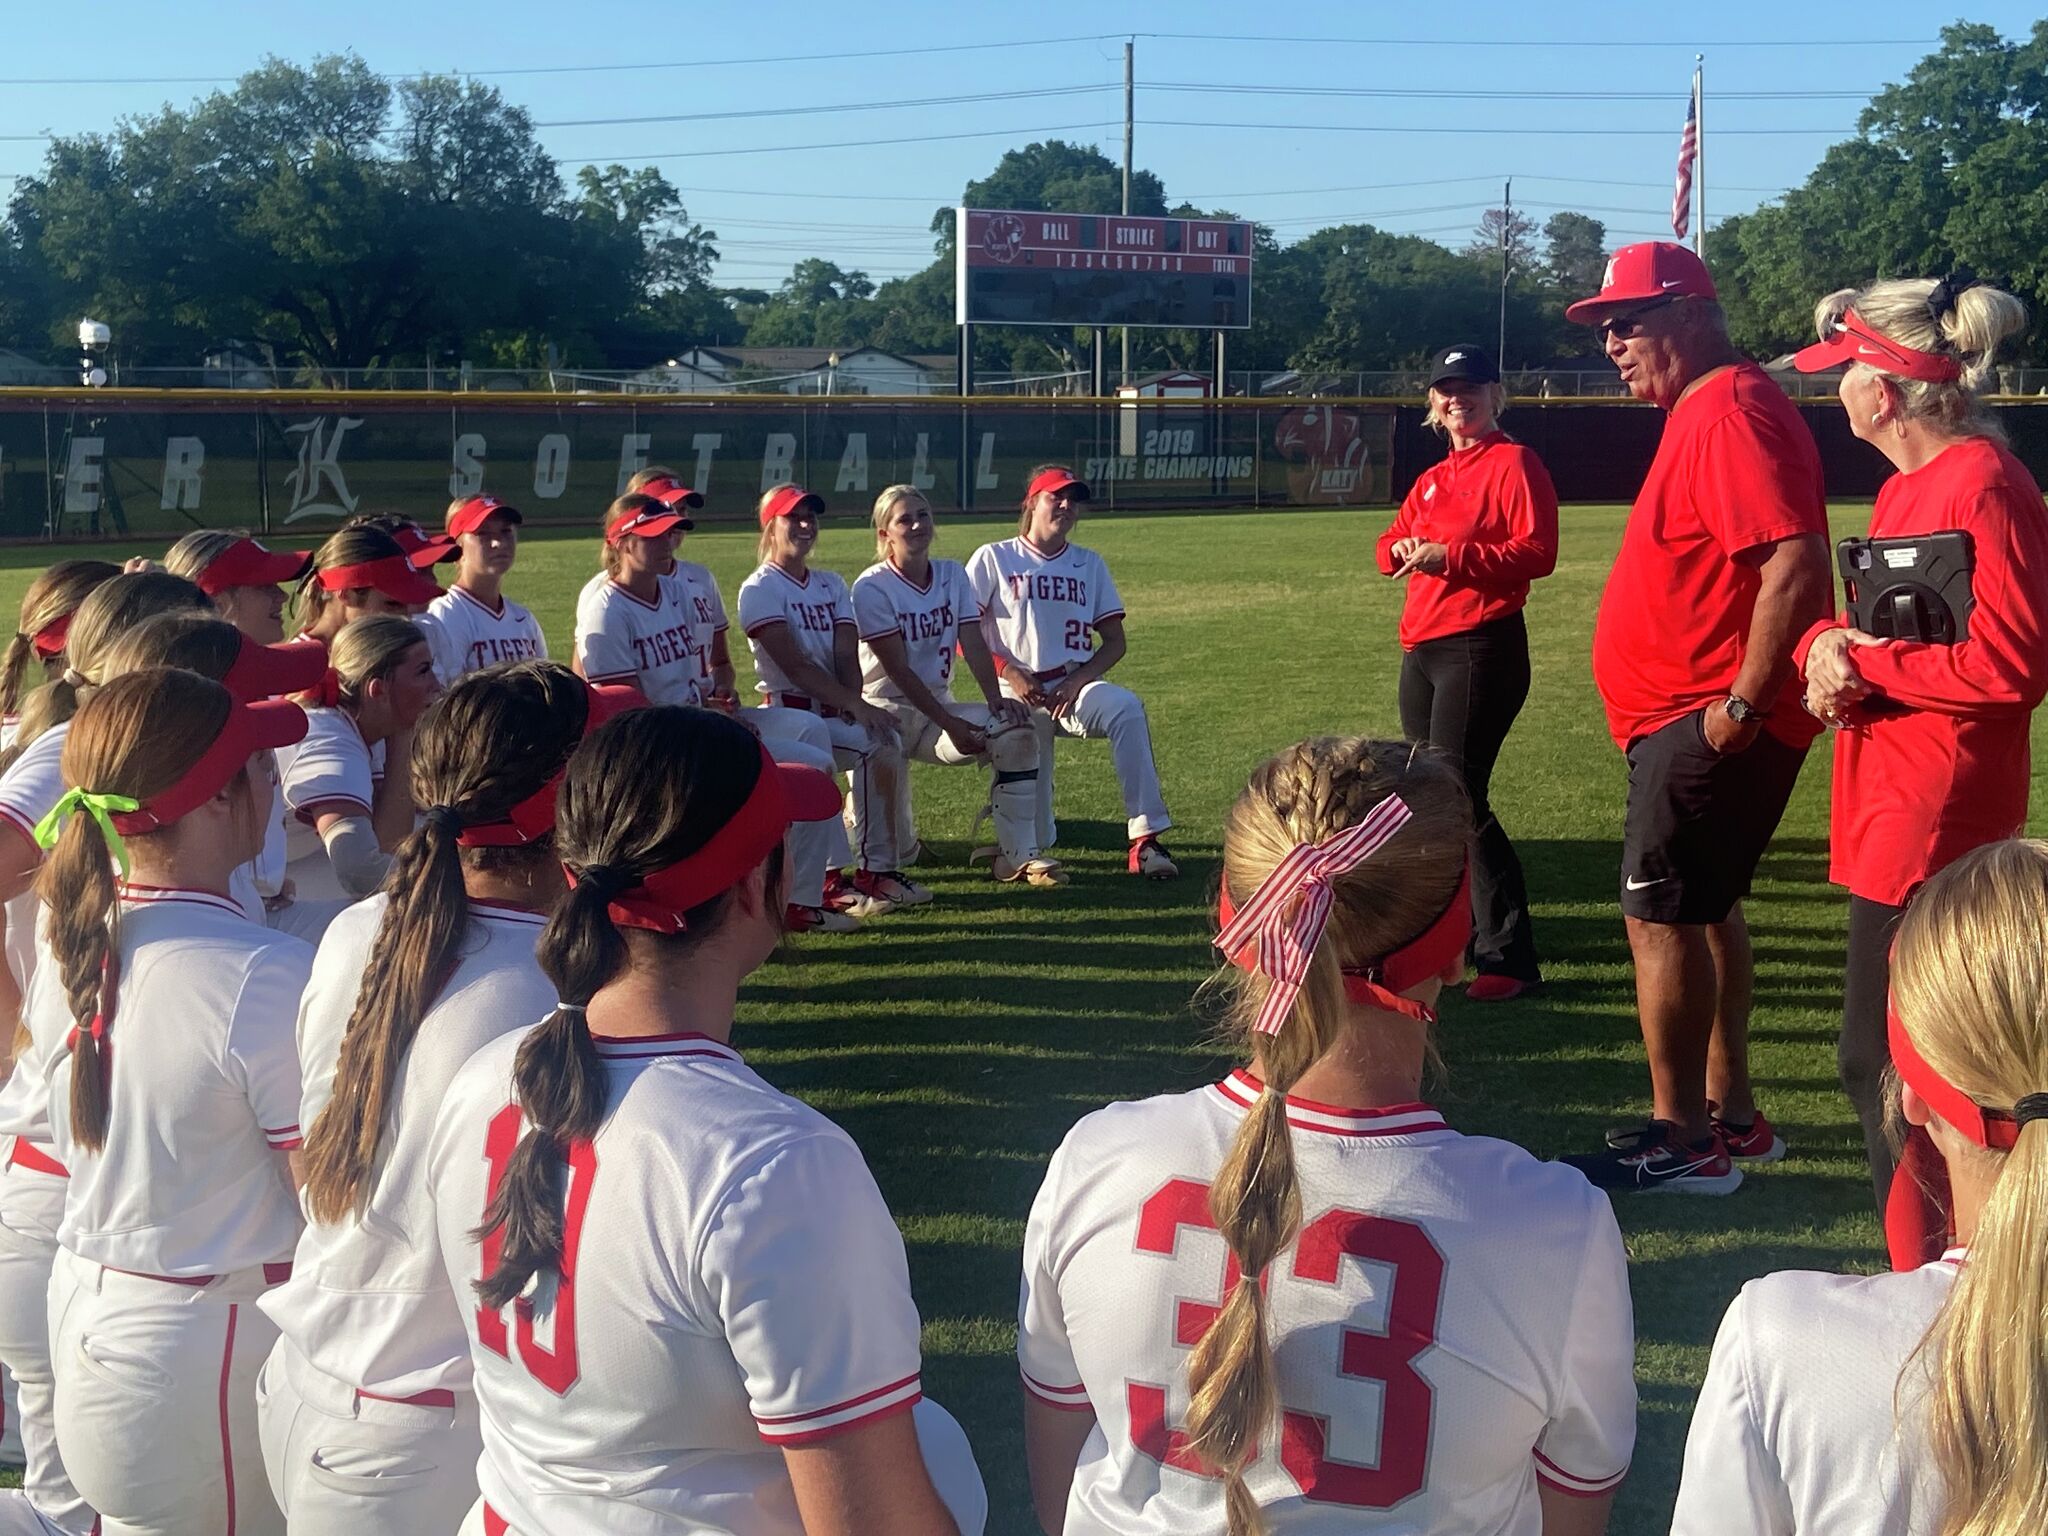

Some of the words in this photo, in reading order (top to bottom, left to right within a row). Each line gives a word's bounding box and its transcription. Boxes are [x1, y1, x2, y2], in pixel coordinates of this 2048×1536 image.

[1042, 223, 1070, 240] BALL
[1116, 227, 1155, 246] STRIKE
[1197, 230, 1218, 248] OUT
[1213, 258, 1236, 273] TOTAL
[1144, 429, 1194, 456] 2019
[449, 432, 999, 501] SOFTBALL
[1084, 457, 1138, 481] STATE
[1143, 455, 1253, 480] CHAMPIONS
[1008, 575, 1086, 607] TIGERS
[1065, 619, 1093, 651] 25
[1124, 1174, 1450, 1512] 33
